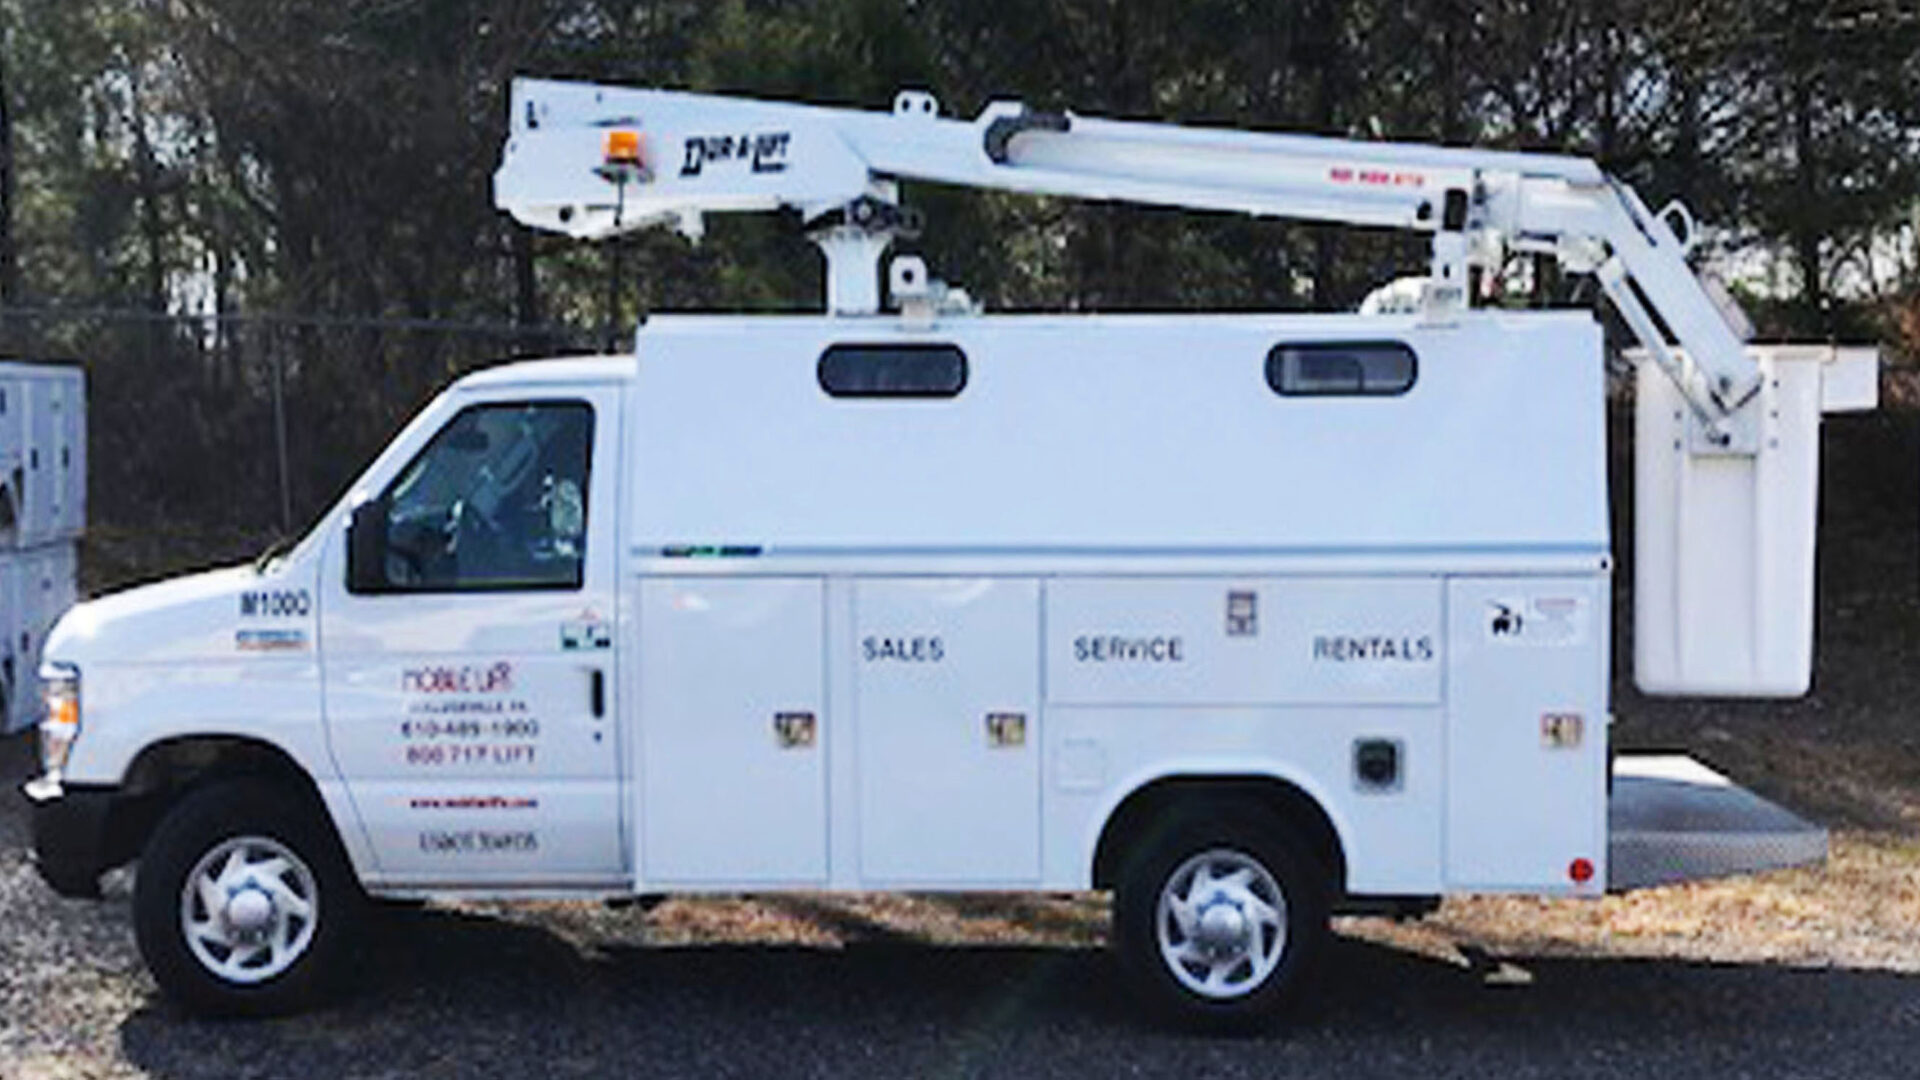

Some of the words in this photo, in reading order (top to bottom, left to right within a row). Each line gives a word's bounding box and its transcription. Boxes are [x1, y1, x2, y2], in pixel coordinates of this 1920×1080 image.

[862, 636, 945, 662] SALES
[1073, 636, 1184, 662] SERVICE
[1313, 635, 1434, 662] RENTALS
